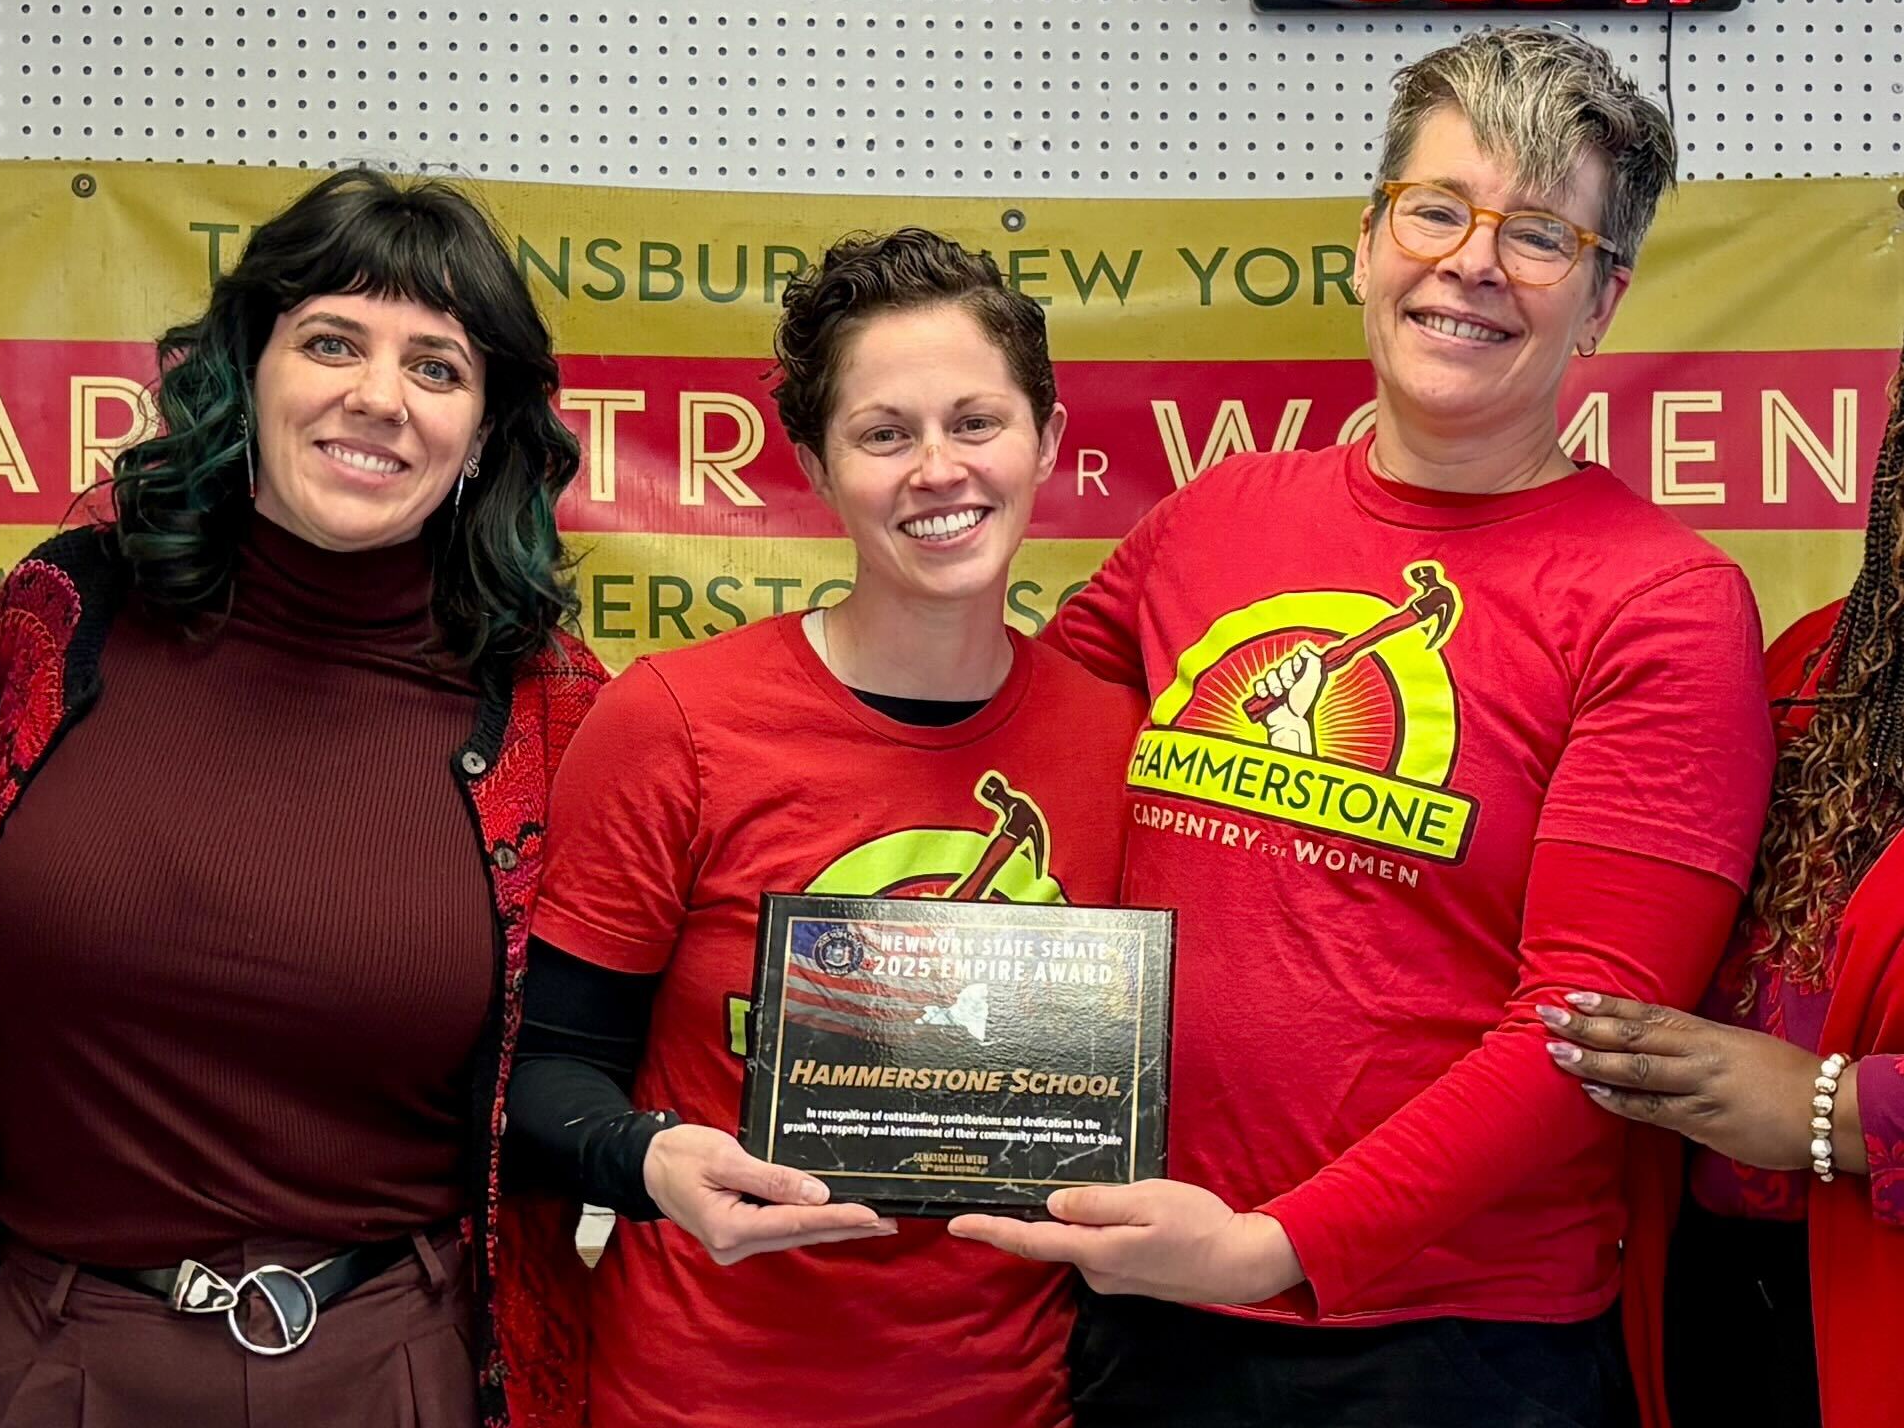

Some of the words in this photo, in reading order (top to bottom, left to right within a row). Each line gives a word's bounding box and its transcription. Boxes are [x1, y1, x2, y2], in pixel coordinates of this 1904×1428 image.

[1008, 248, 1144, 308] EW
[1177, 245, 1362, 308] YOR
[1131, 739, 1455, 846] HAMMERSTONE
[1133, 802, 1263, 851] CARPENTRY
[1261, 843, 1287, 859] FOR
[1294, 838, 1419, 888] WOMEN
[872, 955, 932, 978] 2025
[940, 958, 1025, 983] EMPIRE
[1033, 963, 1114, 986] AWARD
[880, 933, 920, 953] NEW
[926, 935, 974, 956] YORK
[982, 936, 1034, 958] STATE
[1040, 939, 1108, 961] SENATE
[788, 1059, 1004, 1094] HAMMERSTONE
[1008, 1068, 1123, 1098] SCHOOL
